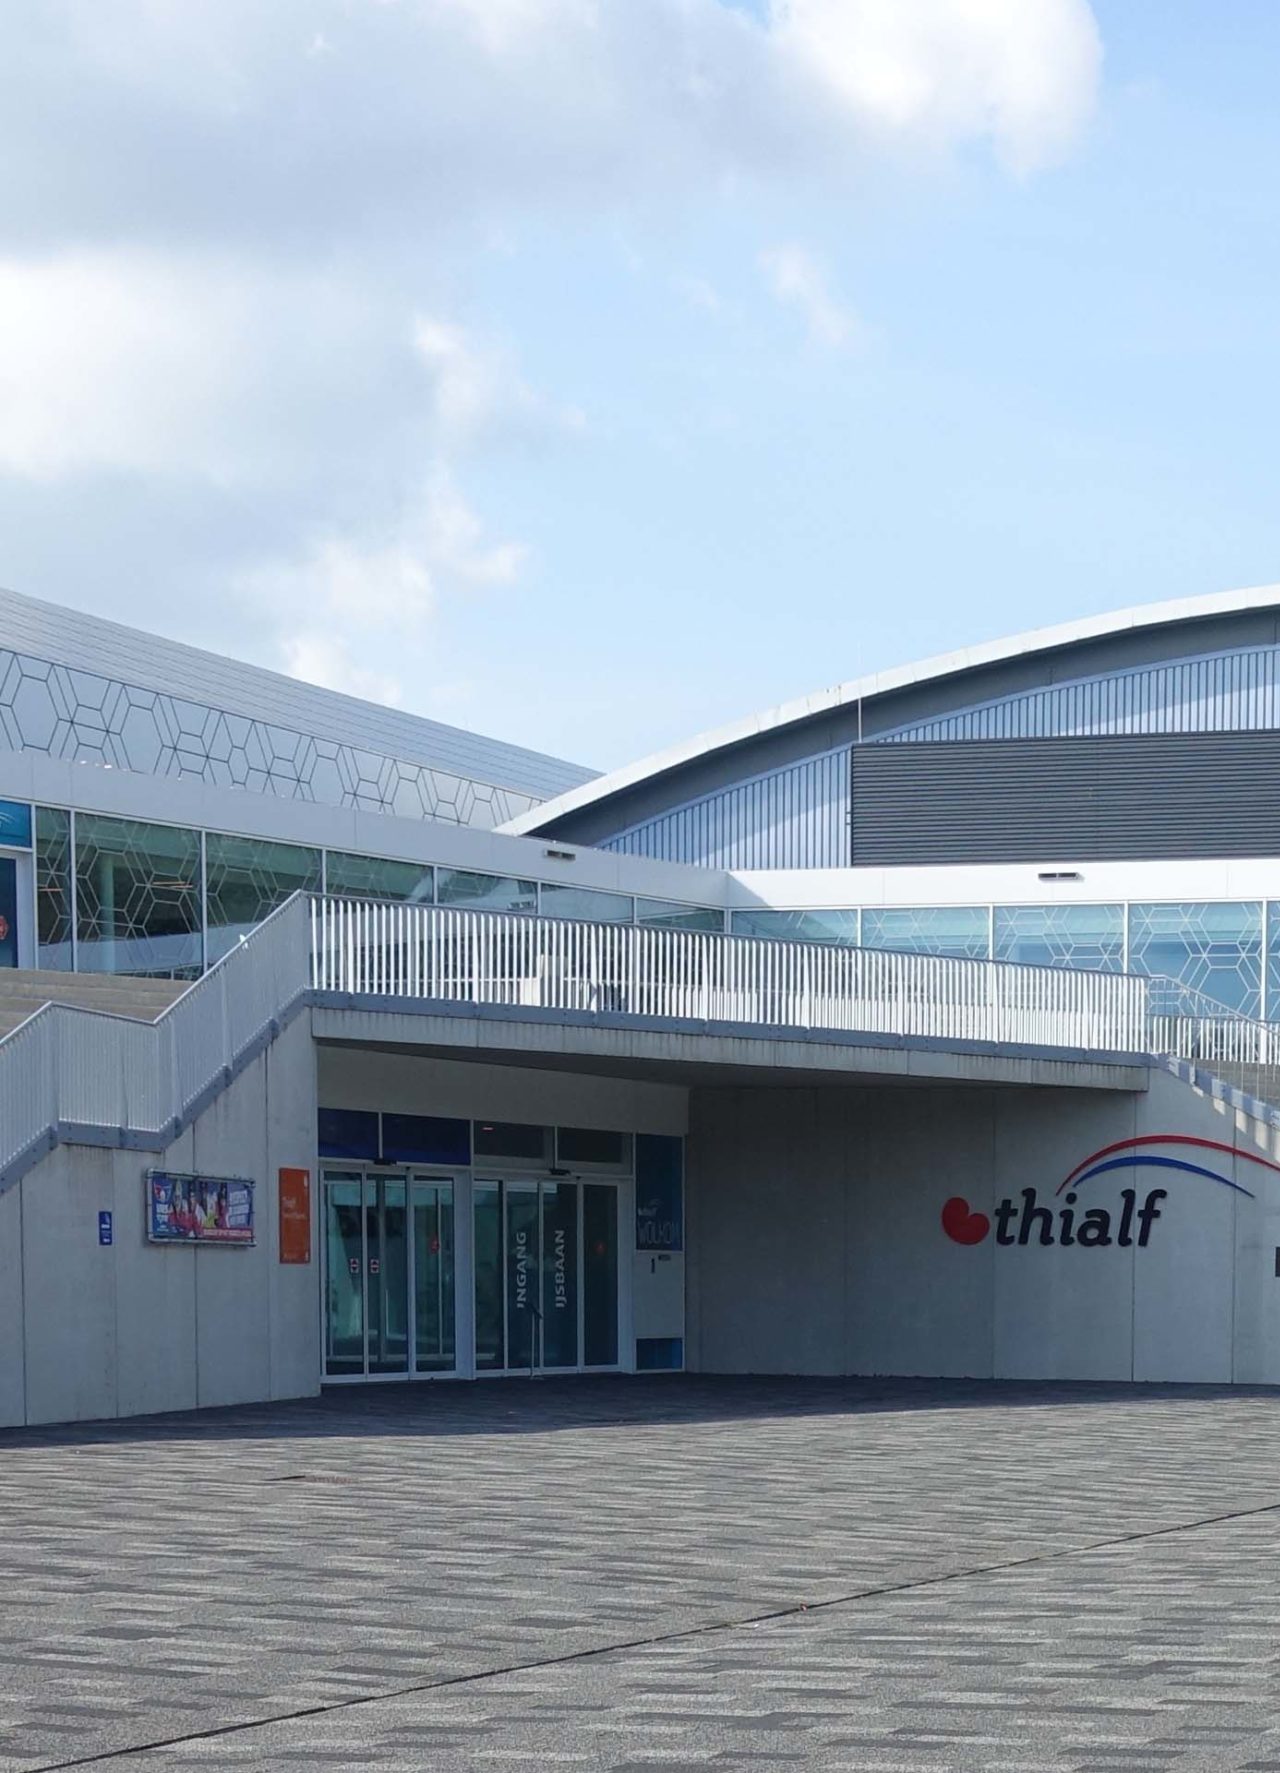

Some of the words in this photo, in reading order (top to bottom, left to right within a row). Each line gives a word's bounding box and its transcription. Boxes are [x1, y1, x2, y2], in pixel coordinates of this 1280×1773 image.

[994, 1187, 1168, 1247] thialf
[516, 1231, 528, 1308] INGANG
[555, 1230, 567, 1307] IJSBAAN
